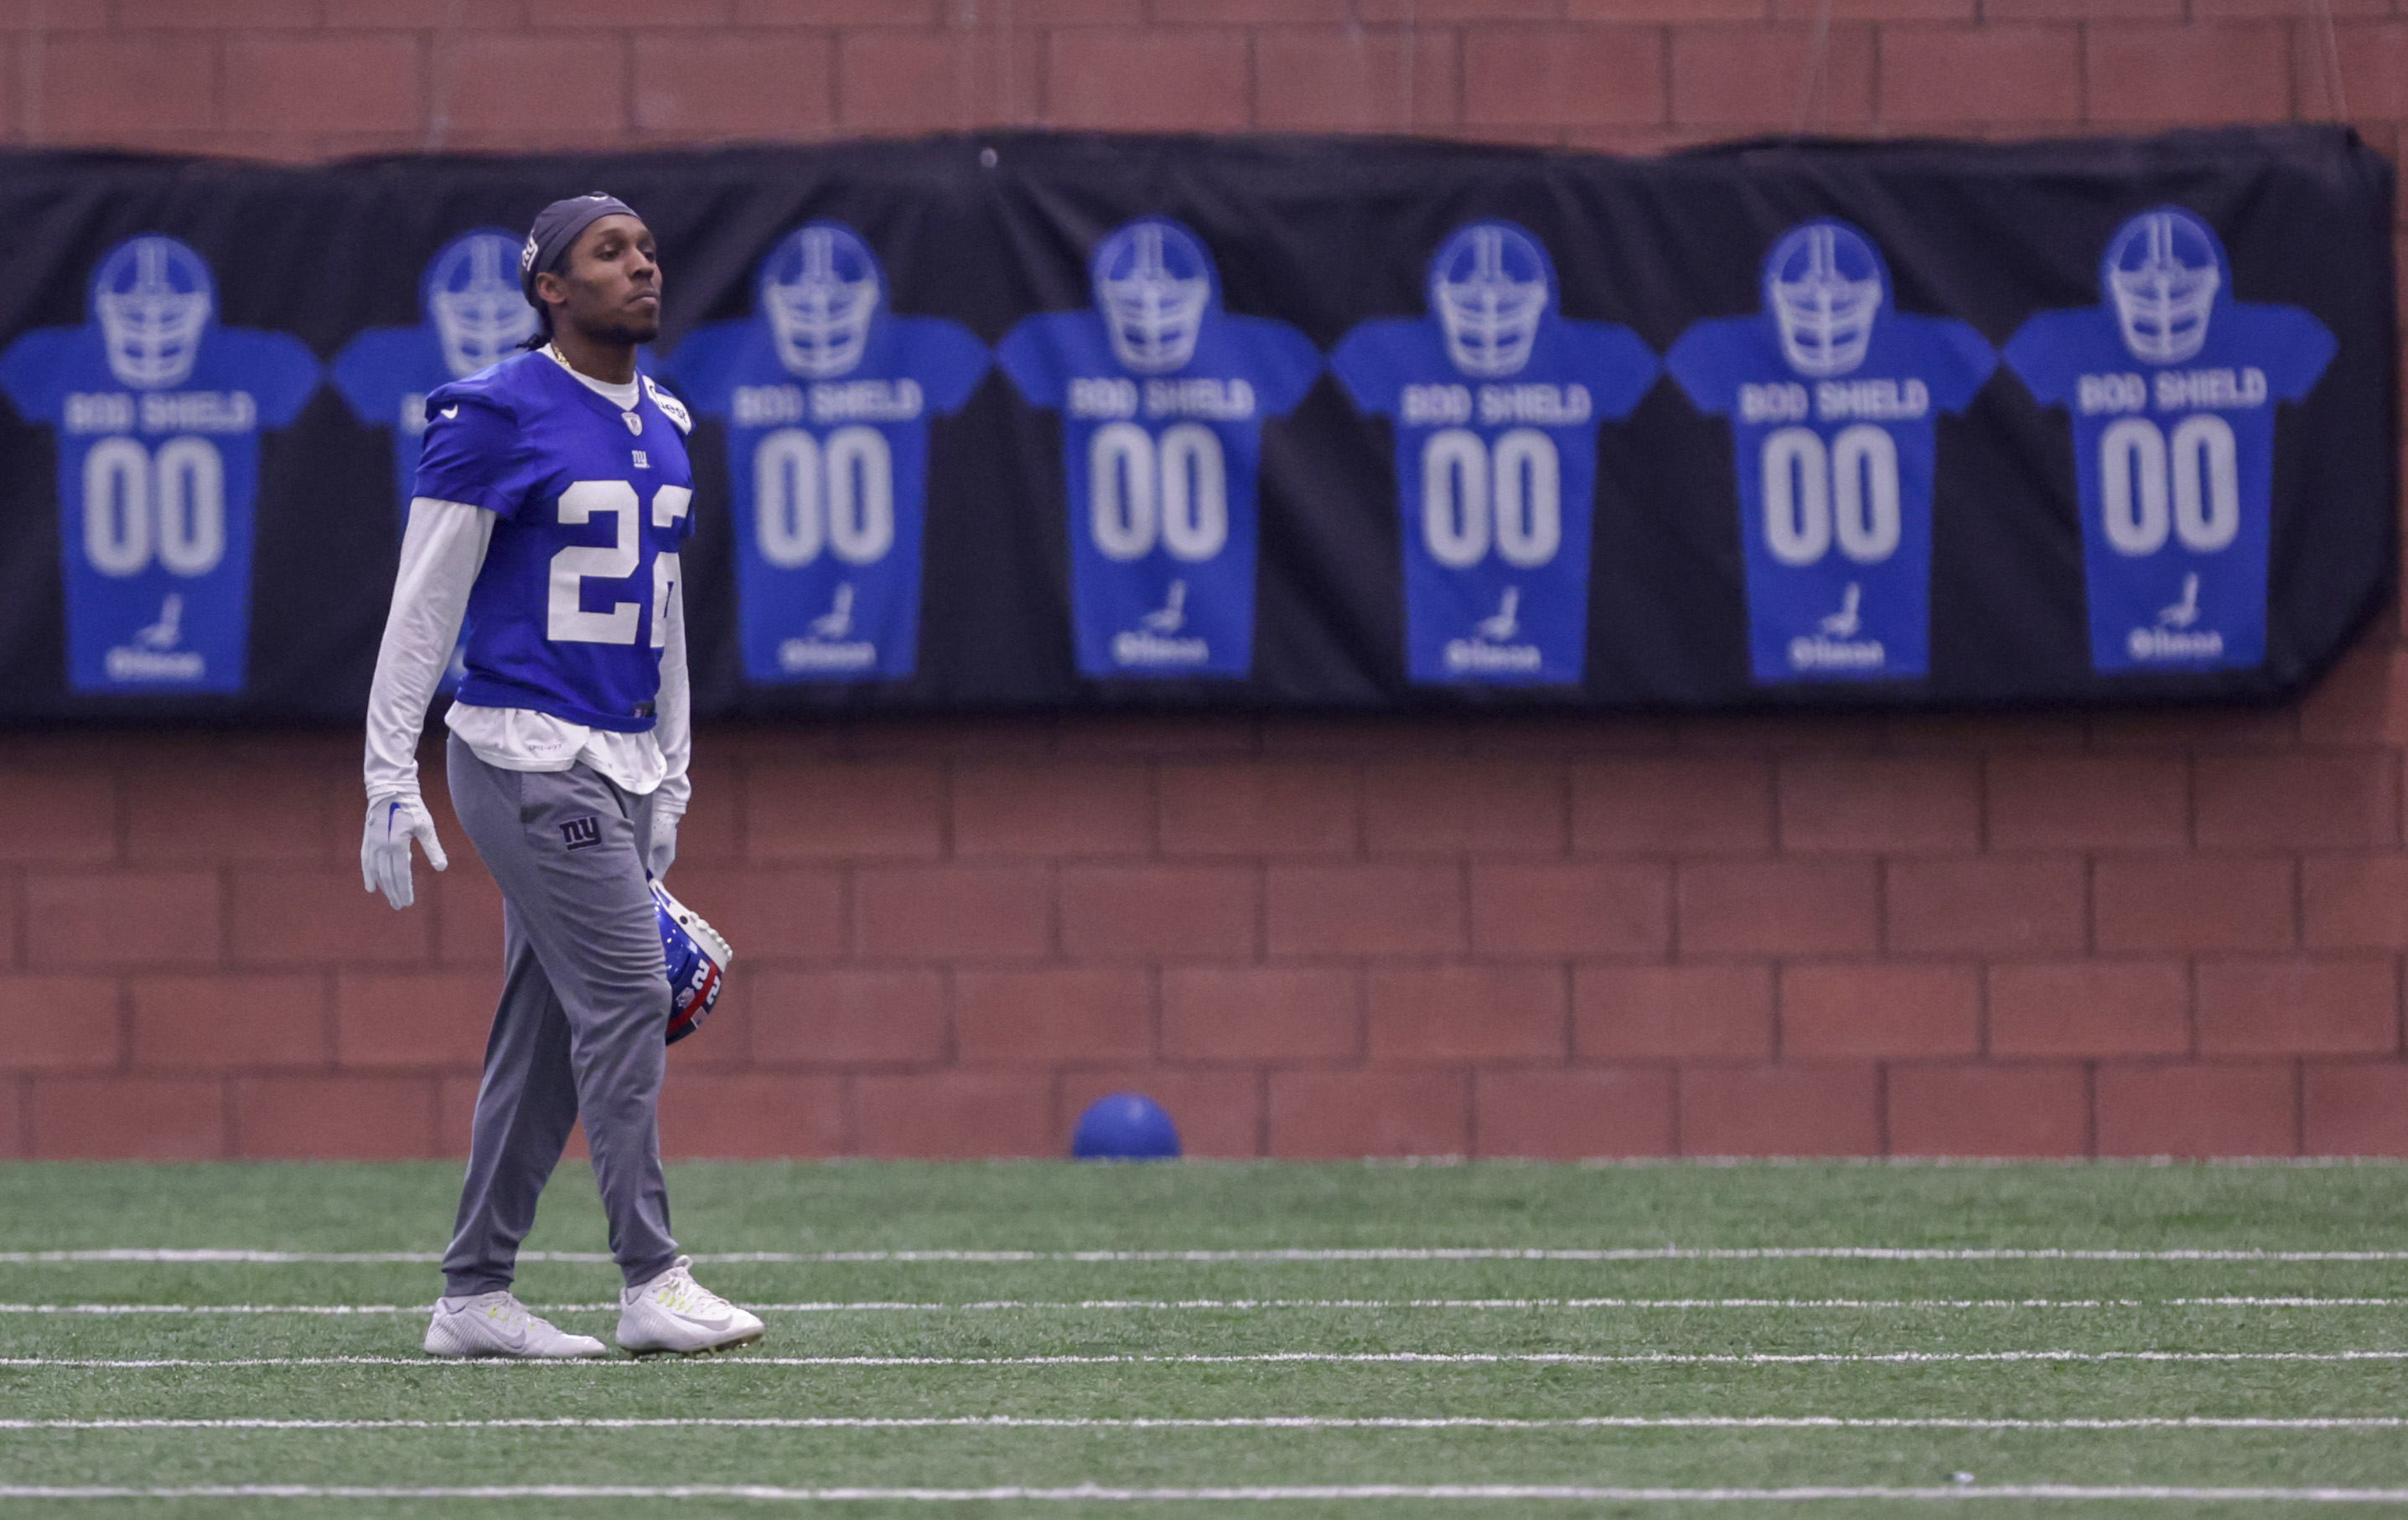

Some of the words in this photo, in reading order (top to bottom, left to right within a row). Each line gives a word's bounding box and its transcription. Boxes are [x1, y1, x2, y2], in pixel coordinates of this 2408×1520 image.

[1816, 379, 1929, 421] SHIELD
[2155, 367, 2267, 411] SHIELD
[85, 437, 224, 576] 00
[756, 426, 893, 566] 00
[1091, 421, 1227, 561] 00
[1424, 429, 1560, 566] 00
[1763, 425, 1900, 565] 00
[2100, 414, 2240, 556] 00
[559, 816, 602, 850] ny
